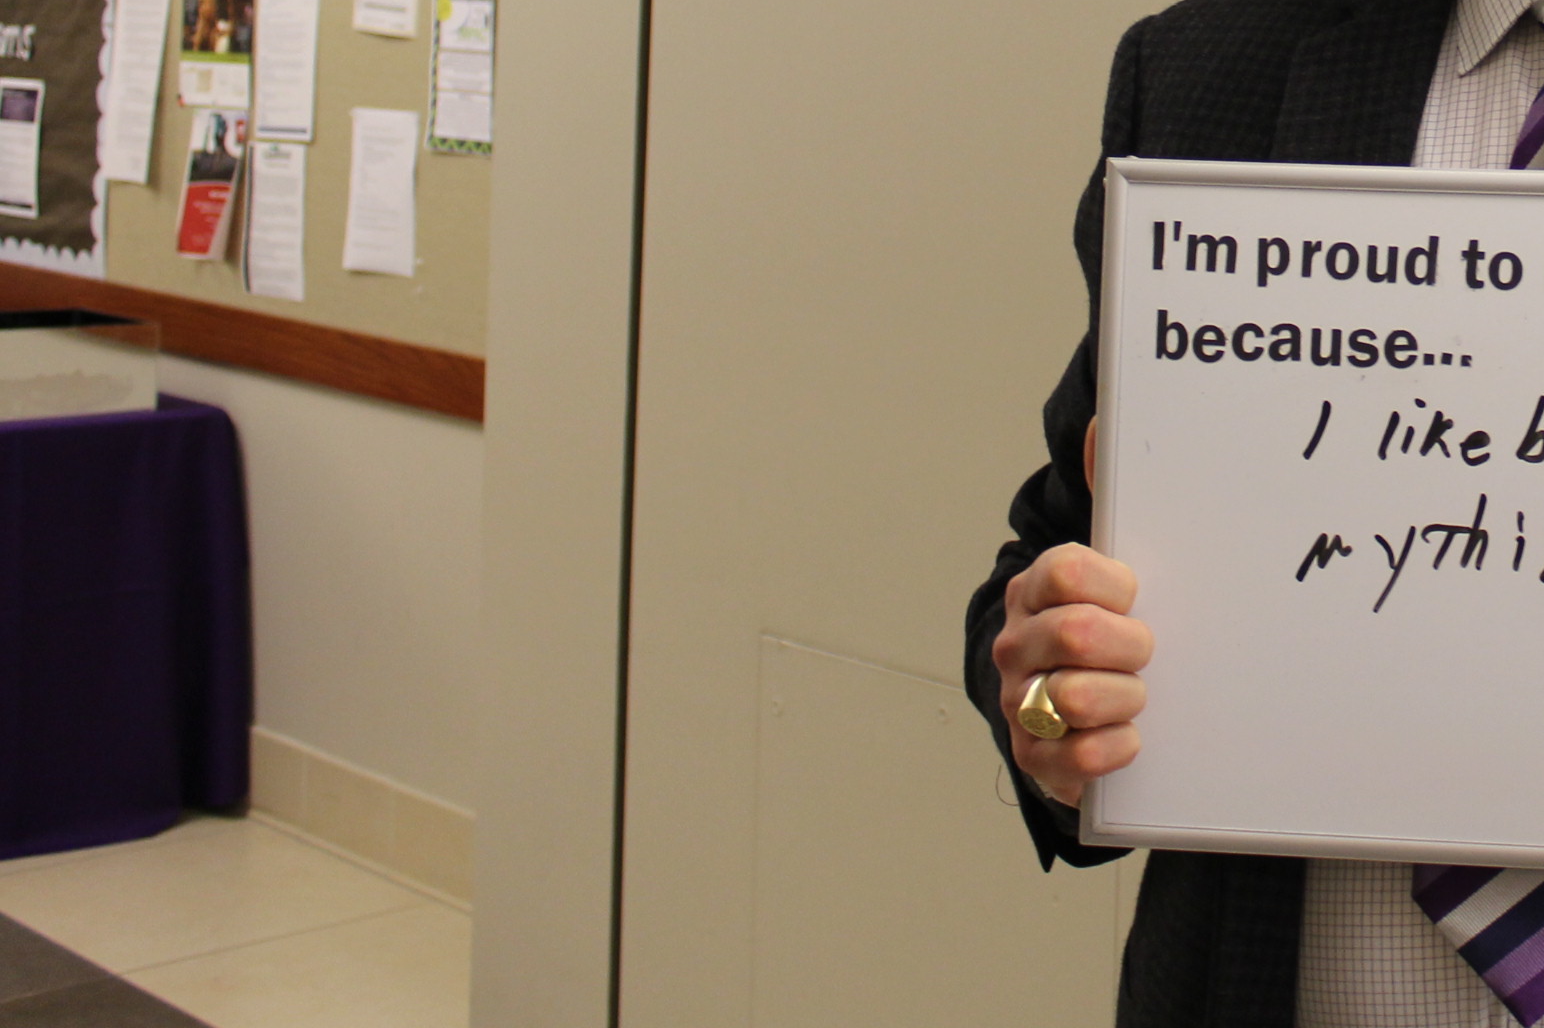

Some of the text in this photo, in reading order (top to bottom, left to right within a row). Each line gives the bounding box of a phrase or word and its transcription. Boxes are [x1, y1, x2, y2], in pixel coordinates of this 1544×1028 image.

[1150, 220, 1237, 275] I'm
[1256, 235, 1439, 289] proud
[1460, 239, 1524, 291] to
[1155, 309, 1474, 369] because...
[1301, 400, 1332, 460] I
